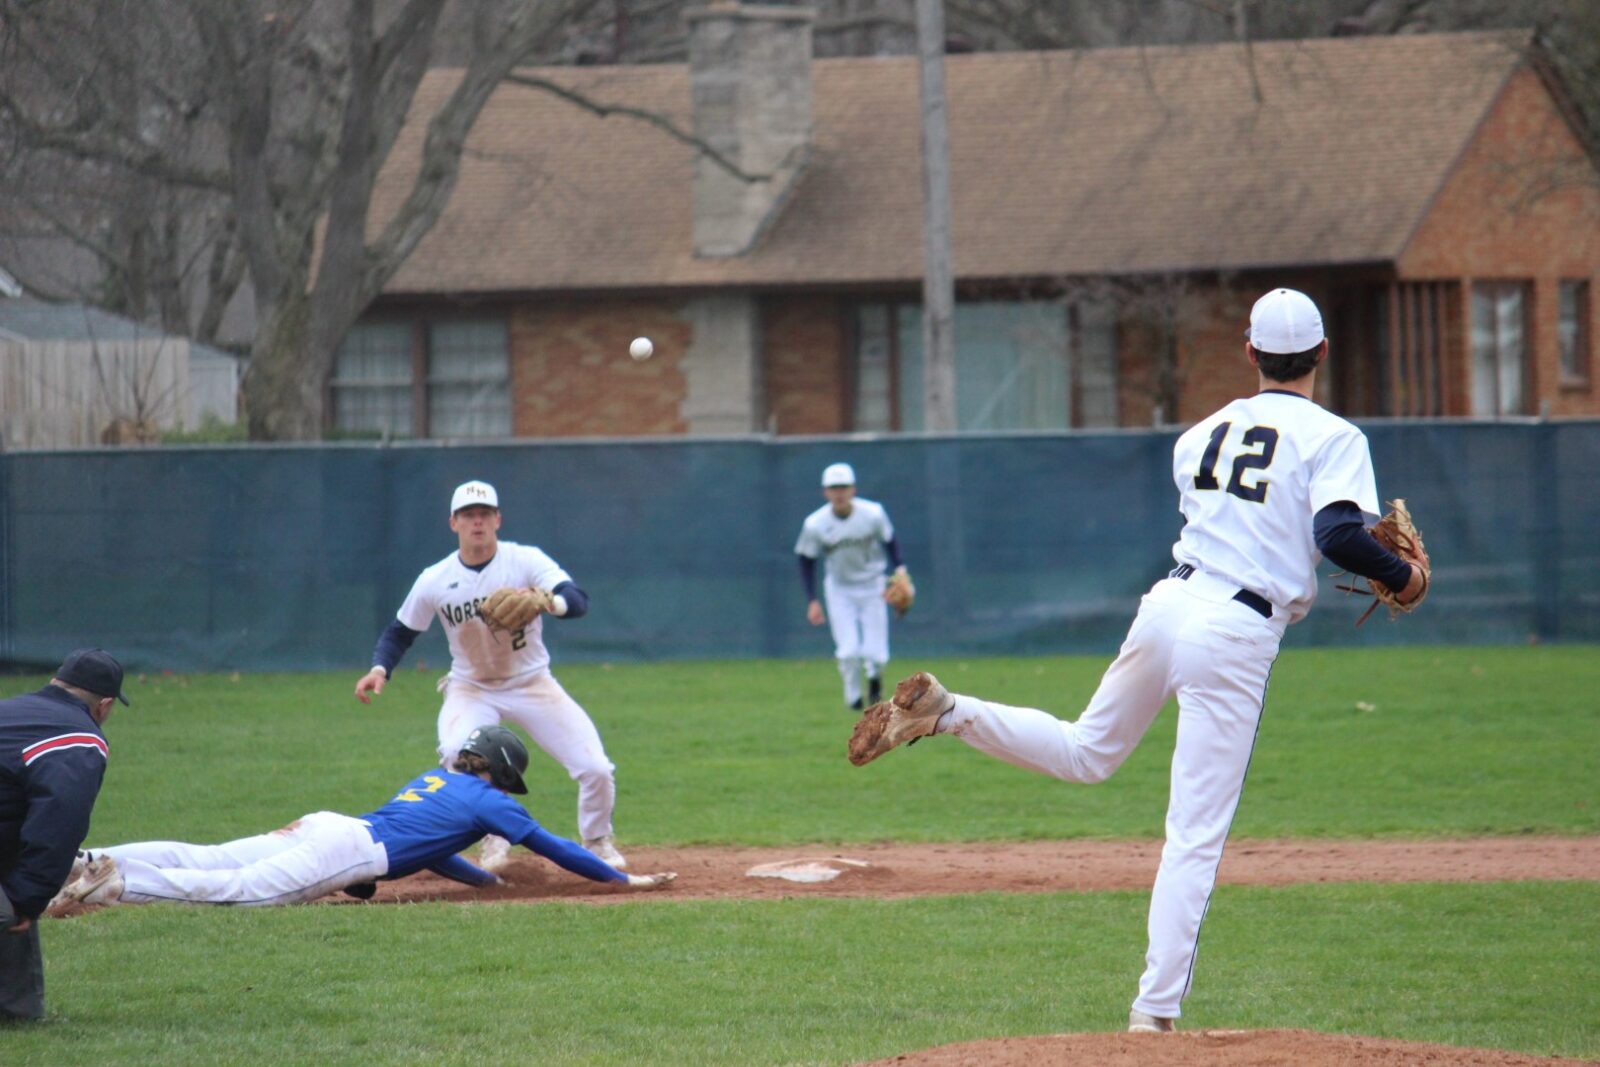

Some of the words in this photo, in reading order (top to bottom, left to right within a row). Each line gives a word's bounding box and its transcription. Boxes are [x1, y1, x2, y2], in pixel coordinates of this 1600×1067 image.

[1193, 421, 1279, 504] 12
[441, 597, 488, 627] NORS
[511, 628, 527, 651] 2
[394, 775, 447, 802] 2
